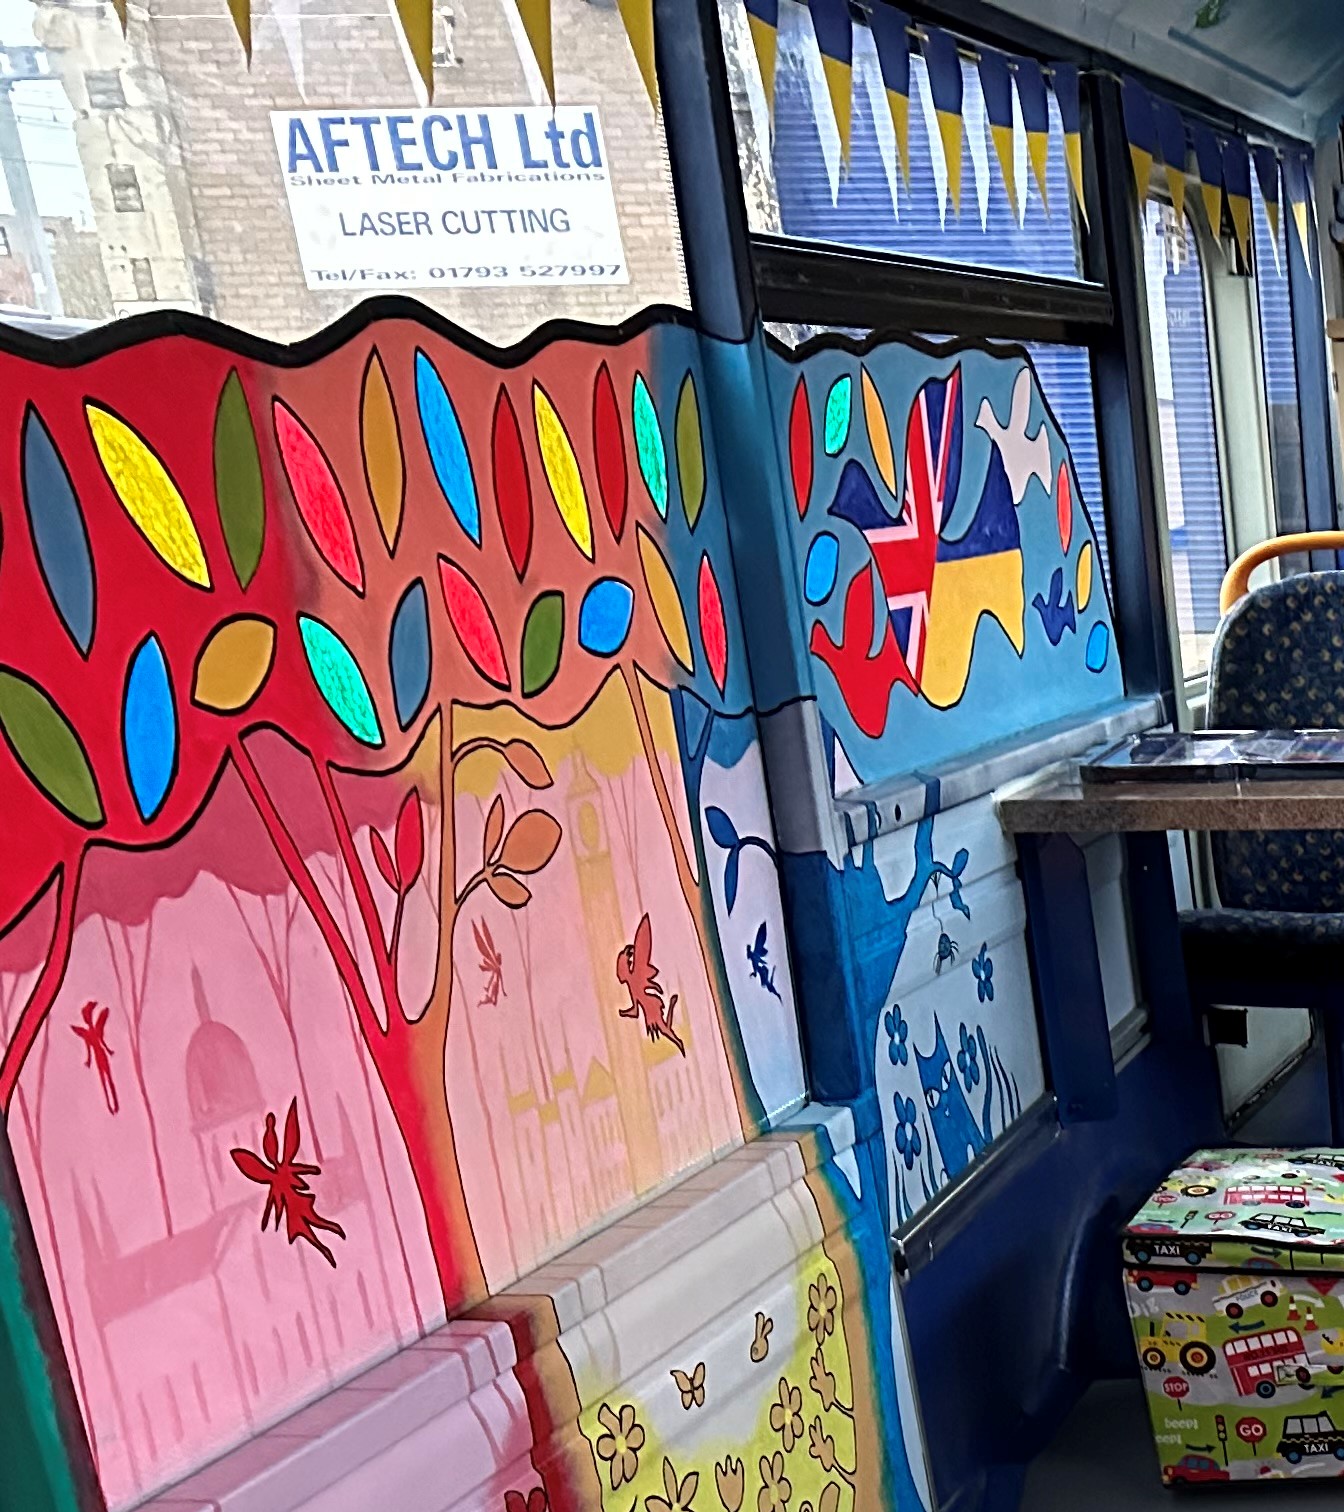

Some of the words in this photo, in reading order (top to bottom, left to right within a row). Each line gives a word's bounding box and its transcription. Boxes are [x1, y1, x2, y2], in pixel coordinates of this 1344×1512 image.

[287, 113, 498, 173] AFTECH
[515, 111, 602, 170] Ltd
[290, 174, 362, 186] Sheet
[371, 173, 442, 185] Metal
[452, 171, 605, 184] Fabrications
[339, 212, 433, 238] LASER
[441, 207, 571, 235] CUTTING
[310, 268, 416, 283] Tel/Fax:
[429, 265, 508, 279] 01793
[519, 263, 621, 278] 527997
[1154, 1245, 1180, 1256] TAXI
[1163, 1382, 1189, 1393] STOP
[1239, 1424, 1264, 1436] GO
[1155, 1434, 1183, 1445] eep!
[1304, 1443, 1329, 1454] TAXI
